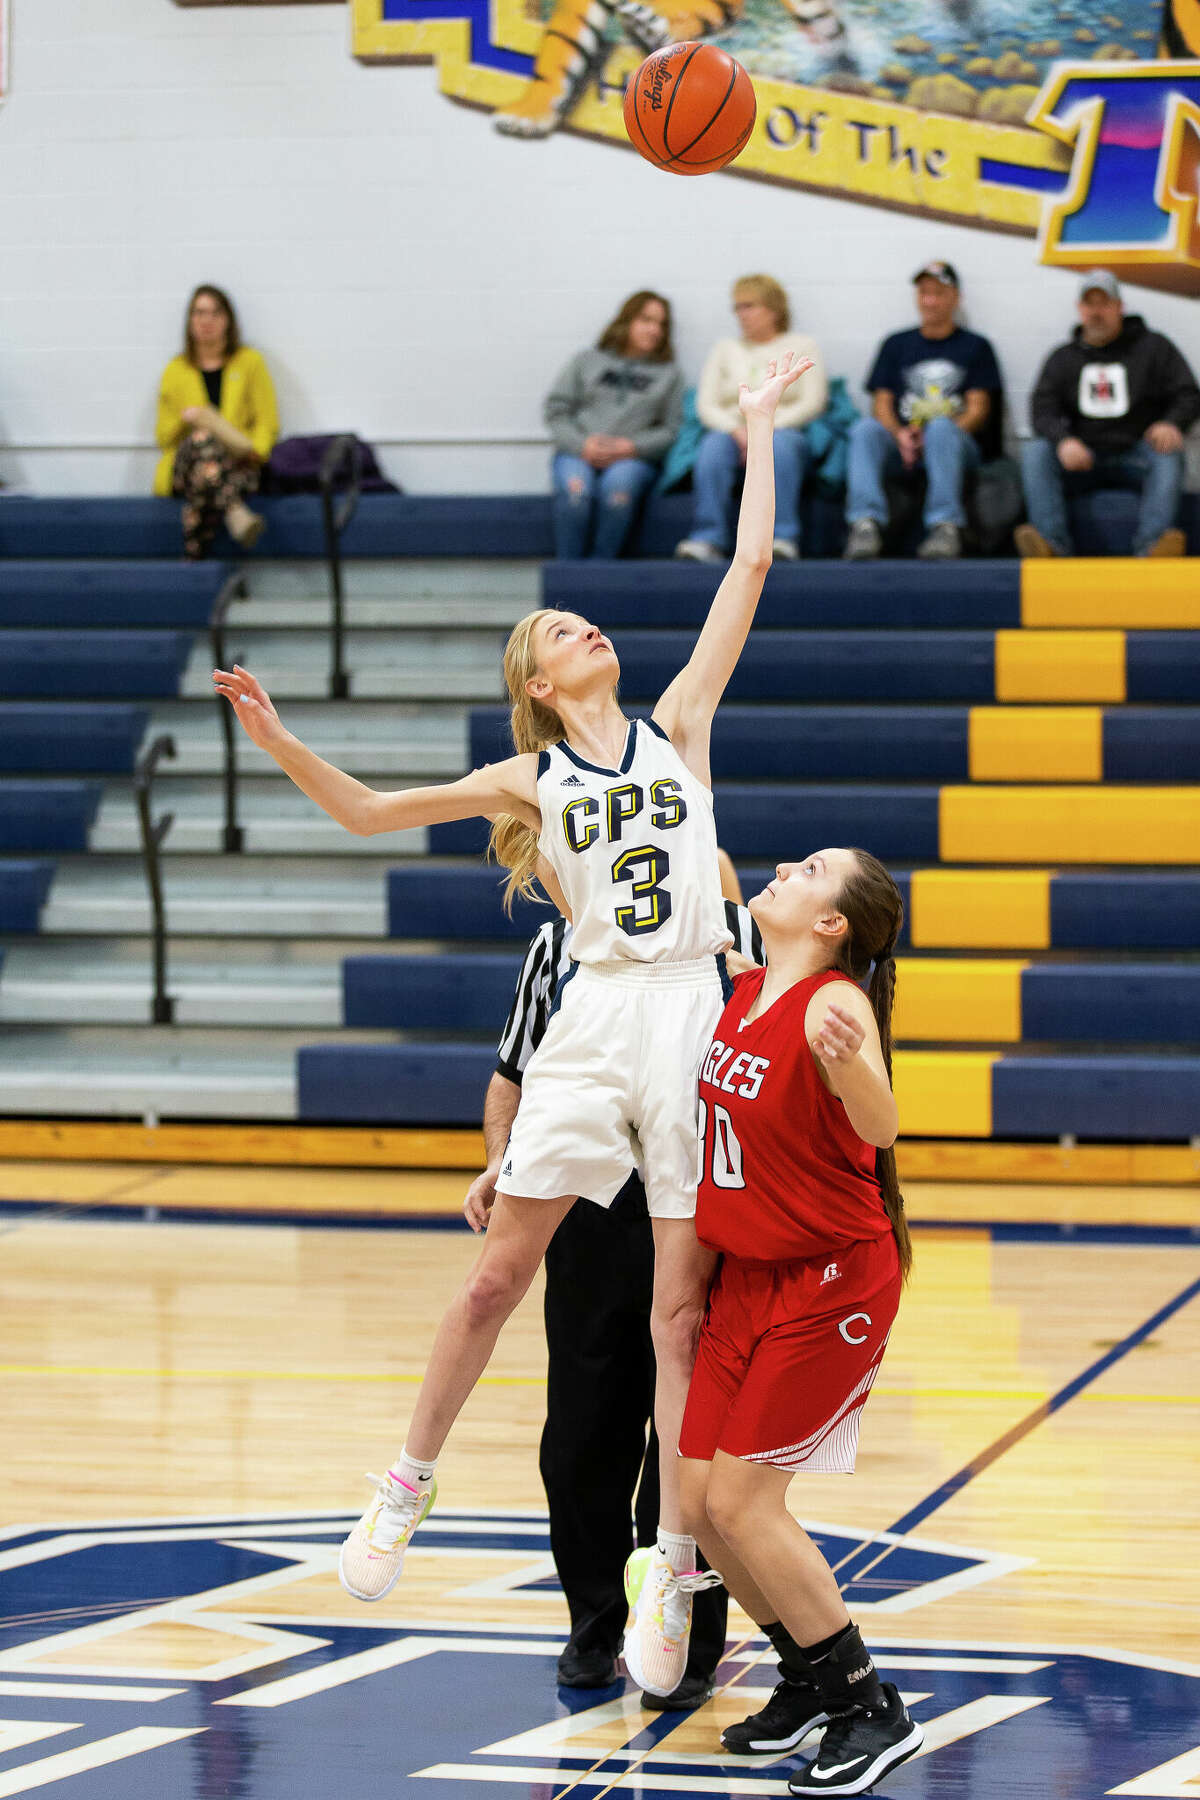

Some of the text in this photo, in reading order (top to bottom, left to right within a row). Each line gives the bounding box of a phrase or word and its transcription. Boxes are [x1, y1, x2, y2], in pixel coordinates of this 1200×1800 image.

[765, 104, 947, 179] Of The
[562, 777, 688, 855] CPS
[611, 844, 673, 937] 3
[698, 1039, 771, 1101] GLES
[838, 1312, 872, 1345] C
